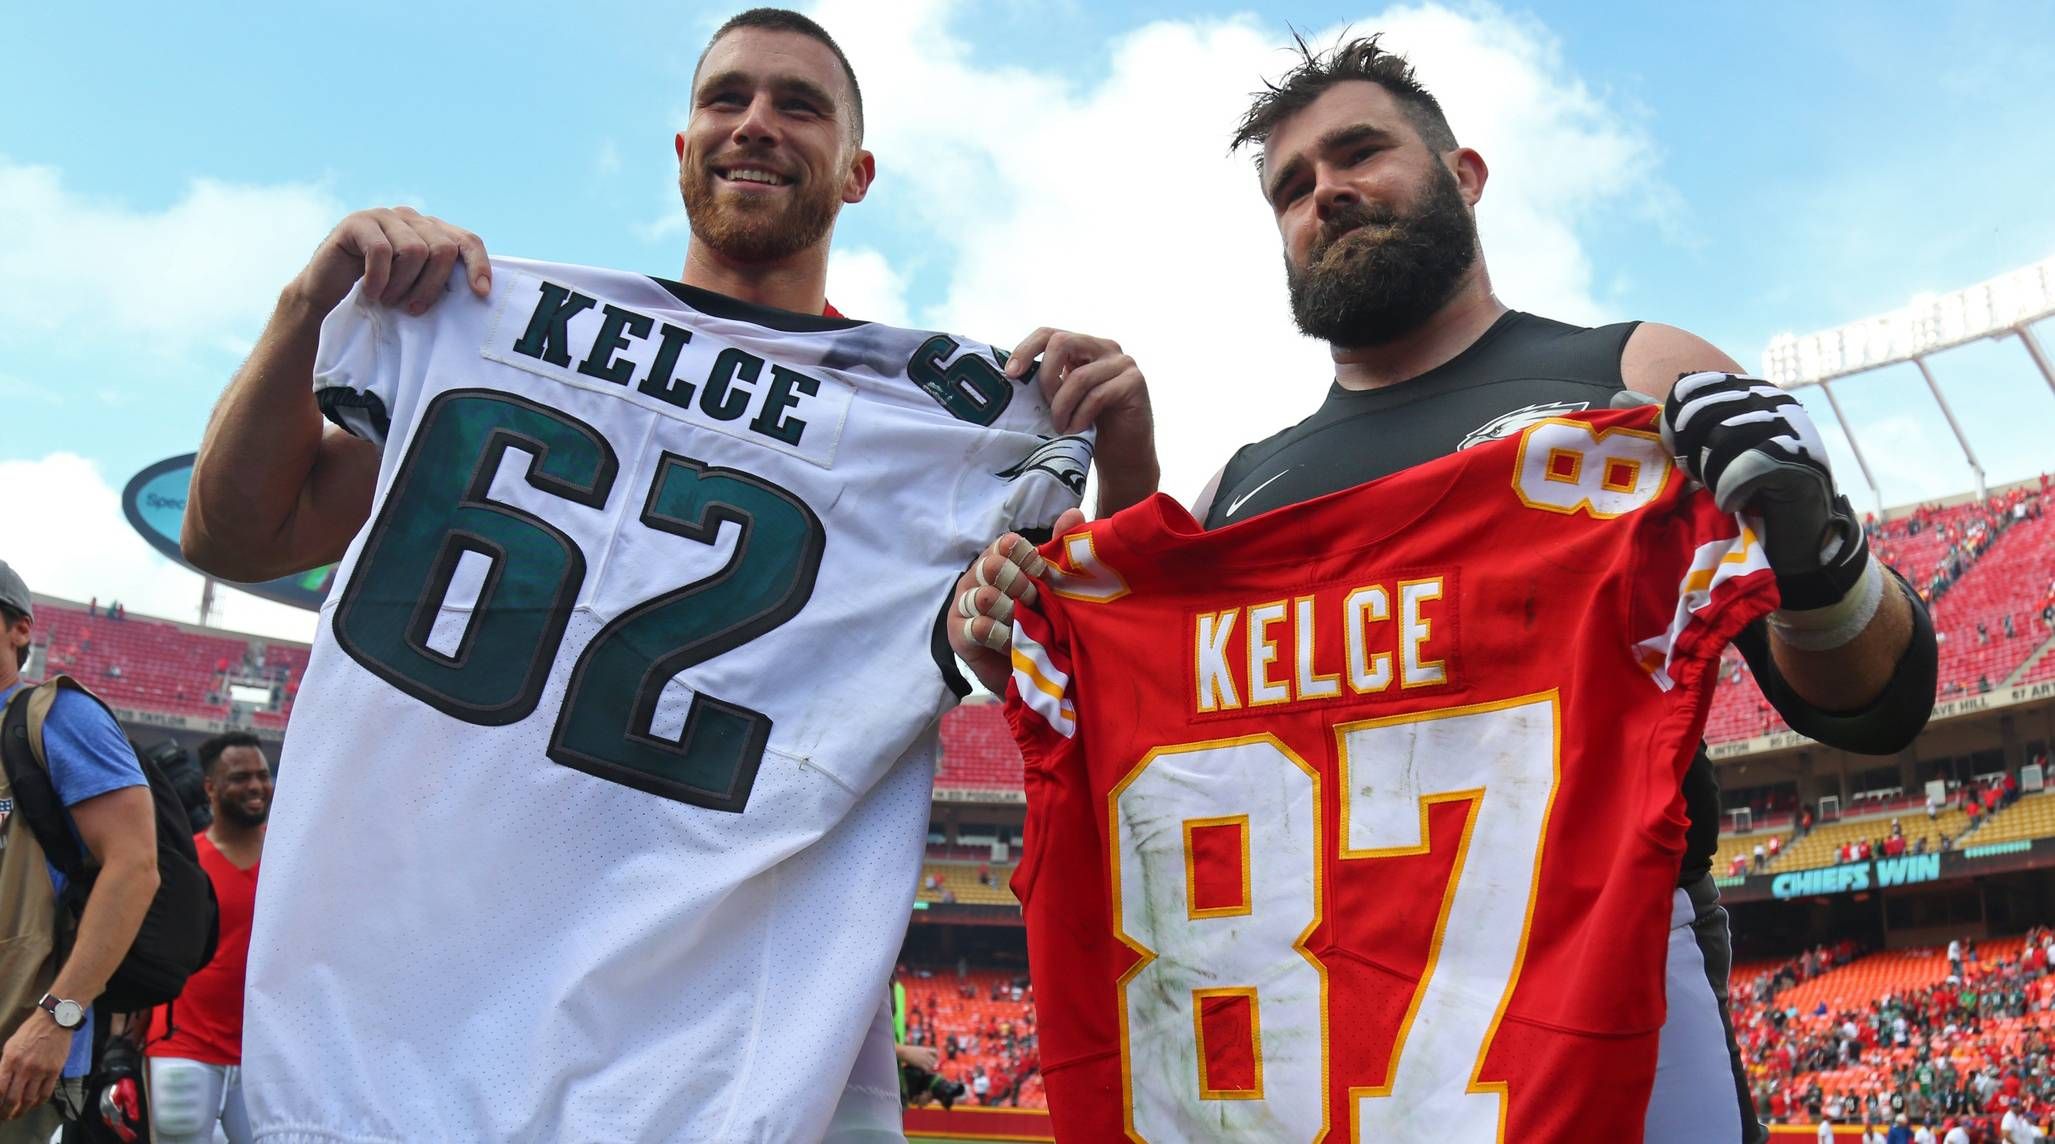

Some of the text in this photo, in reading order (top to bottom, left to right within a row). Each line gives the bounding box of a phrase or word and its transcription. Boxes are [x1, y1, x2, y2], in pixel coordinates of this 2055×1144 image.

[512, 280, 821, 447] KELCE
[331, 387, 827, 814] 62
[1195, 576, 1448, 713] KELCE
[1931, 697, 1989, 717] AVE HILL
[1107, 688, 1561, 1144] 87
[1771, 852, 1940, 899] CHIEFS WIN
